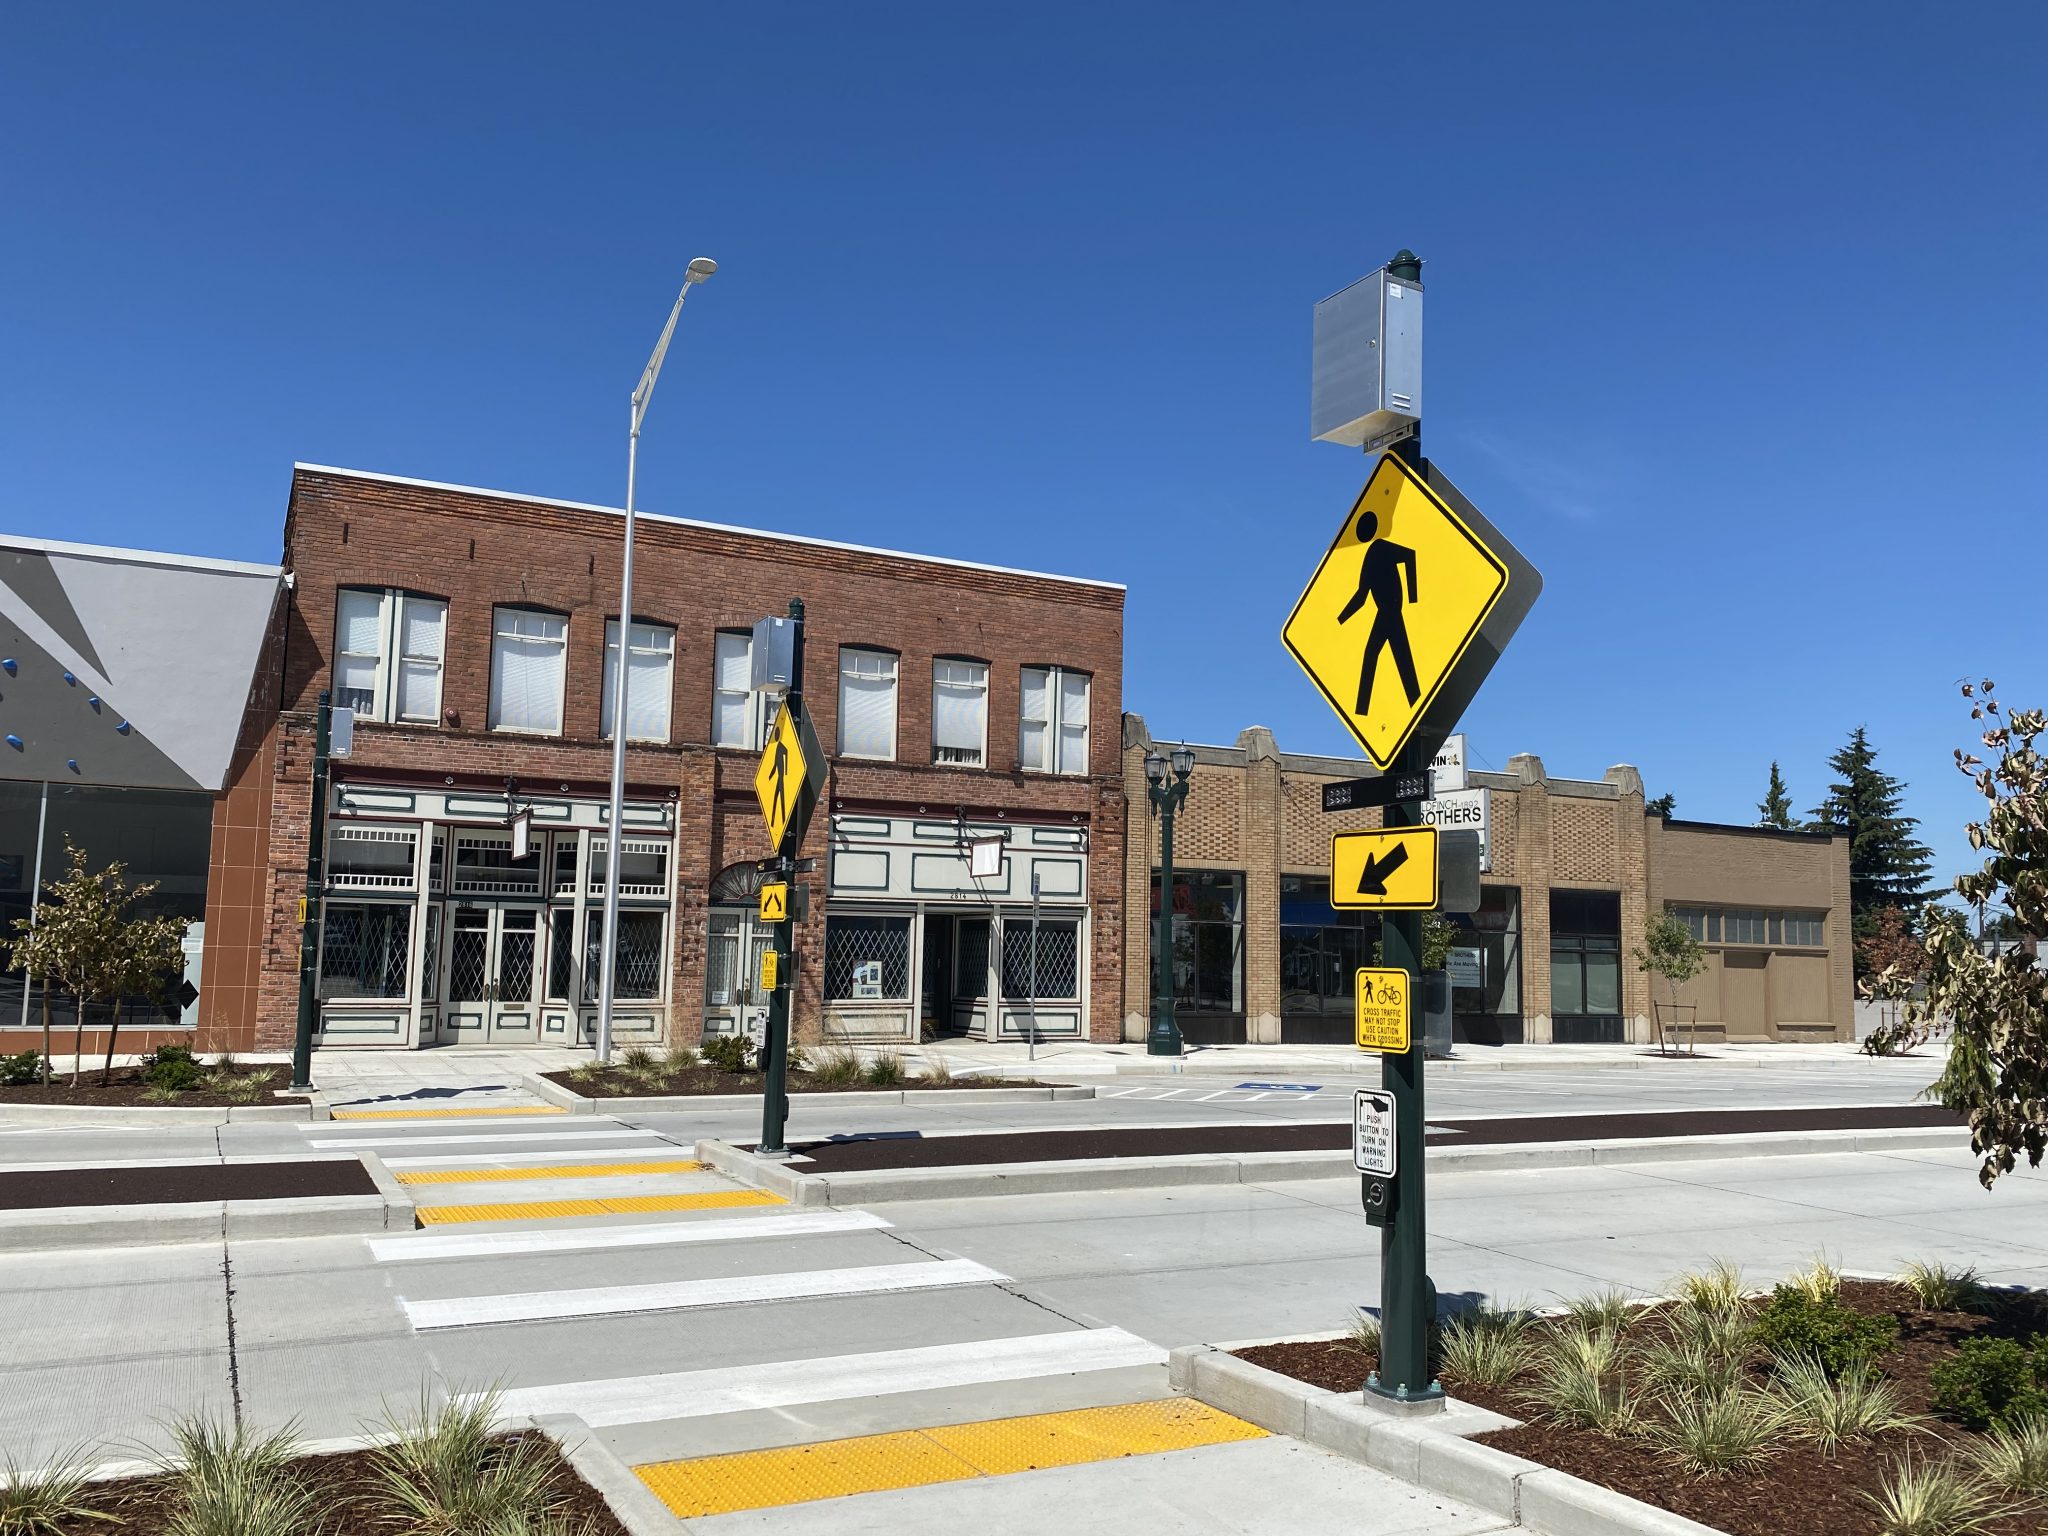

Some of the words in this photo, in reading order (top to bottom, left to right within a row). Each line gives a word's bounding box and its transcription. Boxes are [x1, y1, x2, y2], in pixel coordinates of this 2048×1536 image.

[1431, 755, 1446, 766] VIN
[1420, 807, 1481, 826] ROTHERS
[1363, 1007, 1379, 1016] CROSS
[1380, 1008, 1401, 1017] TRAFFIC
[1364, 1016, 1374, 1025] MAY
[1375, 1017, 1386, 1026] NOT
[1387, 1018, 1400, 1027] STOP
[1366, 1025, 1376, 1034] USE
[1377, 1026, 1398, 1035] CAUTION
[1362, 1034, 1376, 1042] WHEN
[1377, 1035, 1403, 1045] CROSSING
[1366, 1114, 1382, 1124] PUSH
[1359, 1124, 1379, 1134] BUTTON
[1382, 1127, 1389, 1136] TO
[1361, 1135, 1375, 1144] TURN
[1378, 1138, 1386, 1146] ON
[1362, 1146, 1386, 1157] WARNING
[1364, 1158, 1383, 1168] LIGHTS
